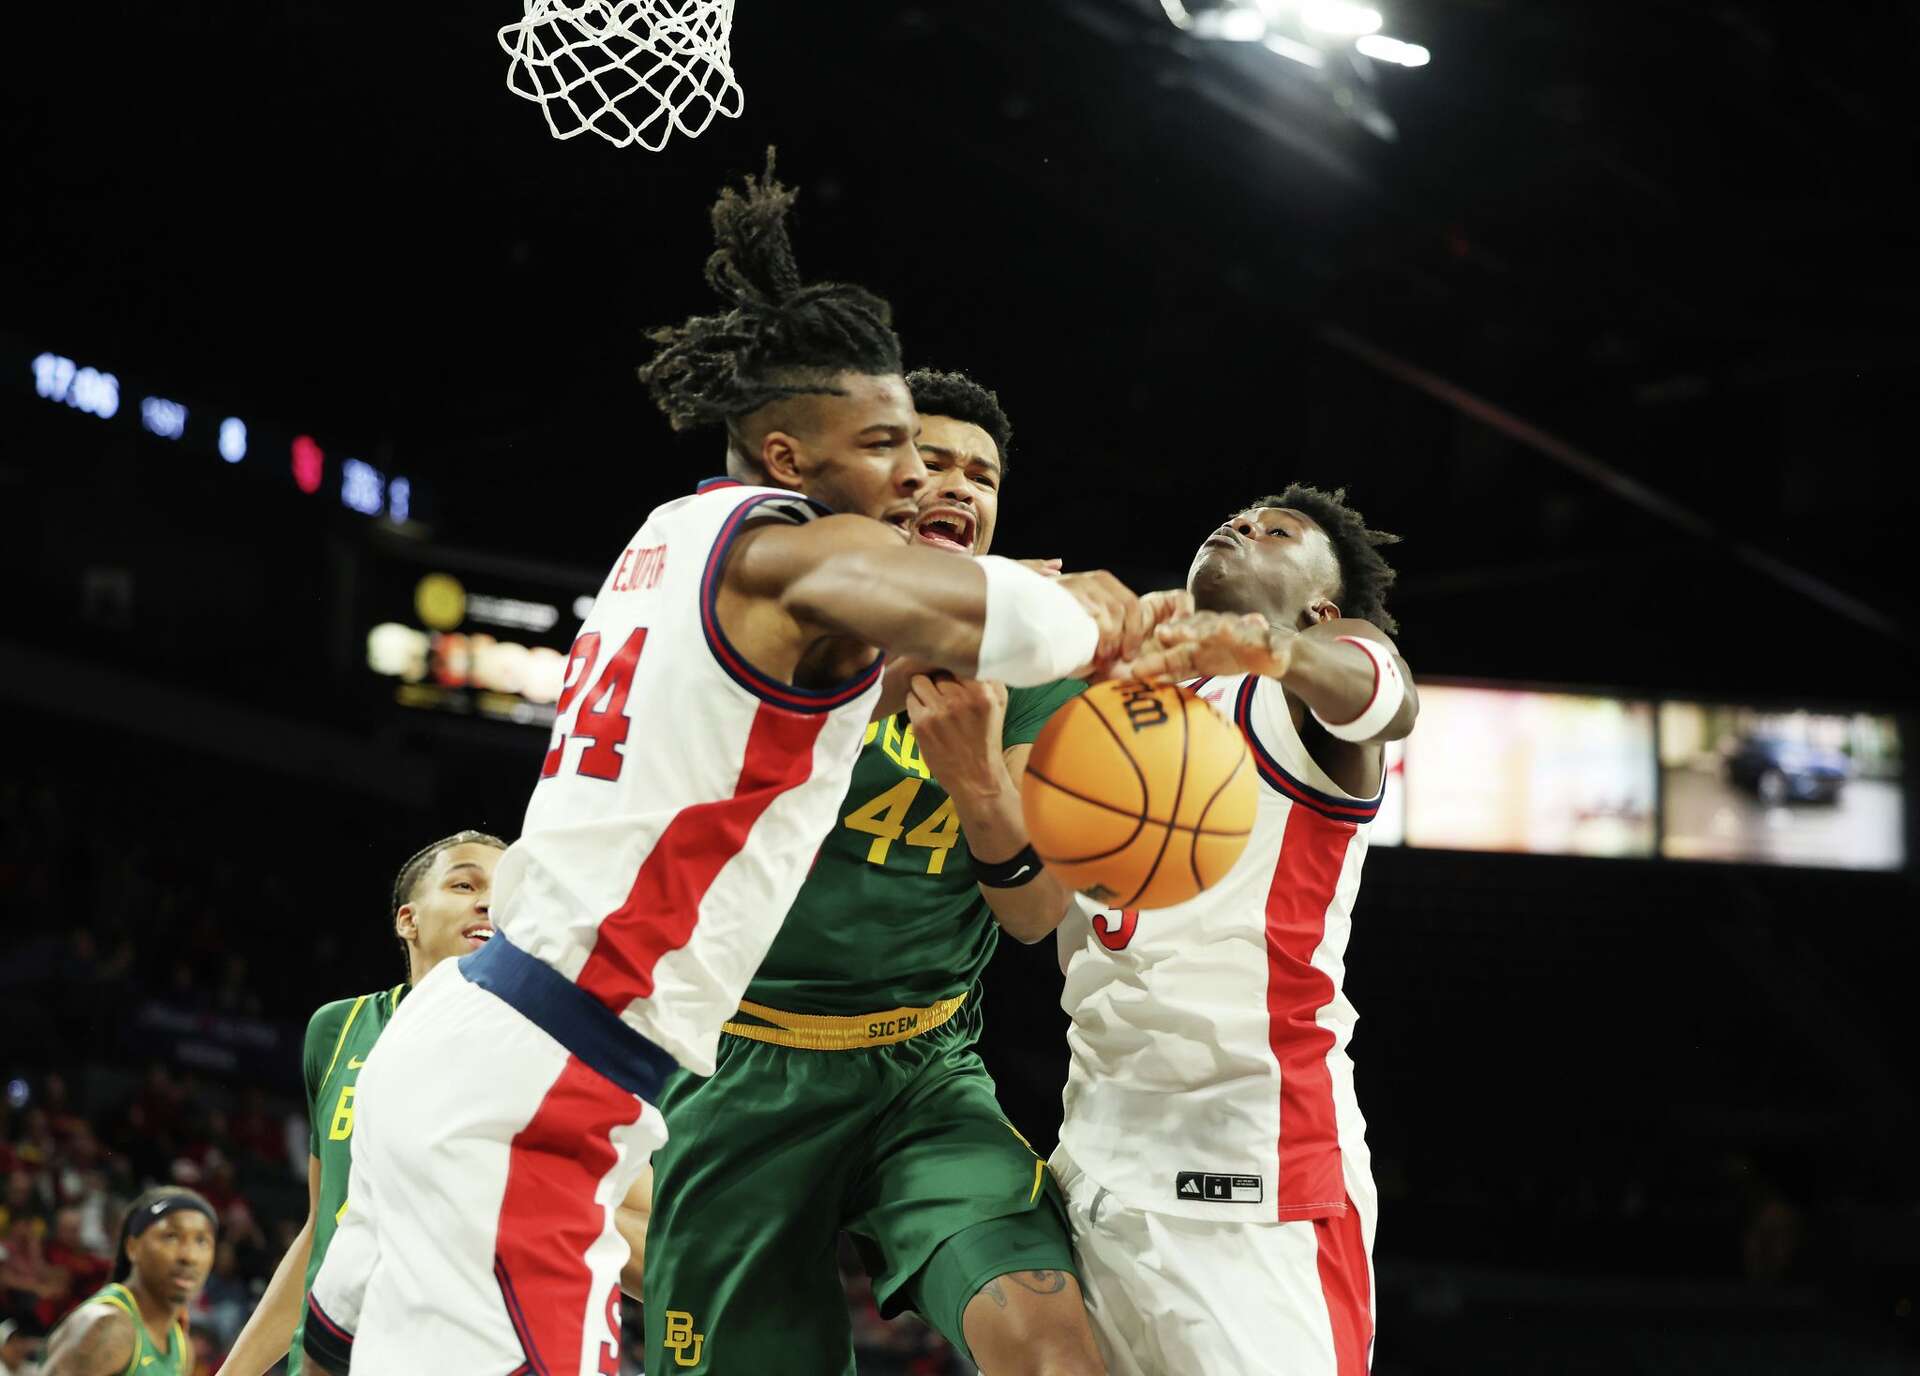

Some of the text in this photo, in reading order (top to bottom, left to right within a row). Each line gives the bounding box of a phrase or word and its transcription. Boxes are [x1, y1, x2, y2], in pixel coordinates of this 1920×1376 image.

[541, 627, 648, 782] 24
[844, 777, 960, 874] 44
[868, 1021, 895, 1038] SIC
[664, 1310, 704, 1367] BU
